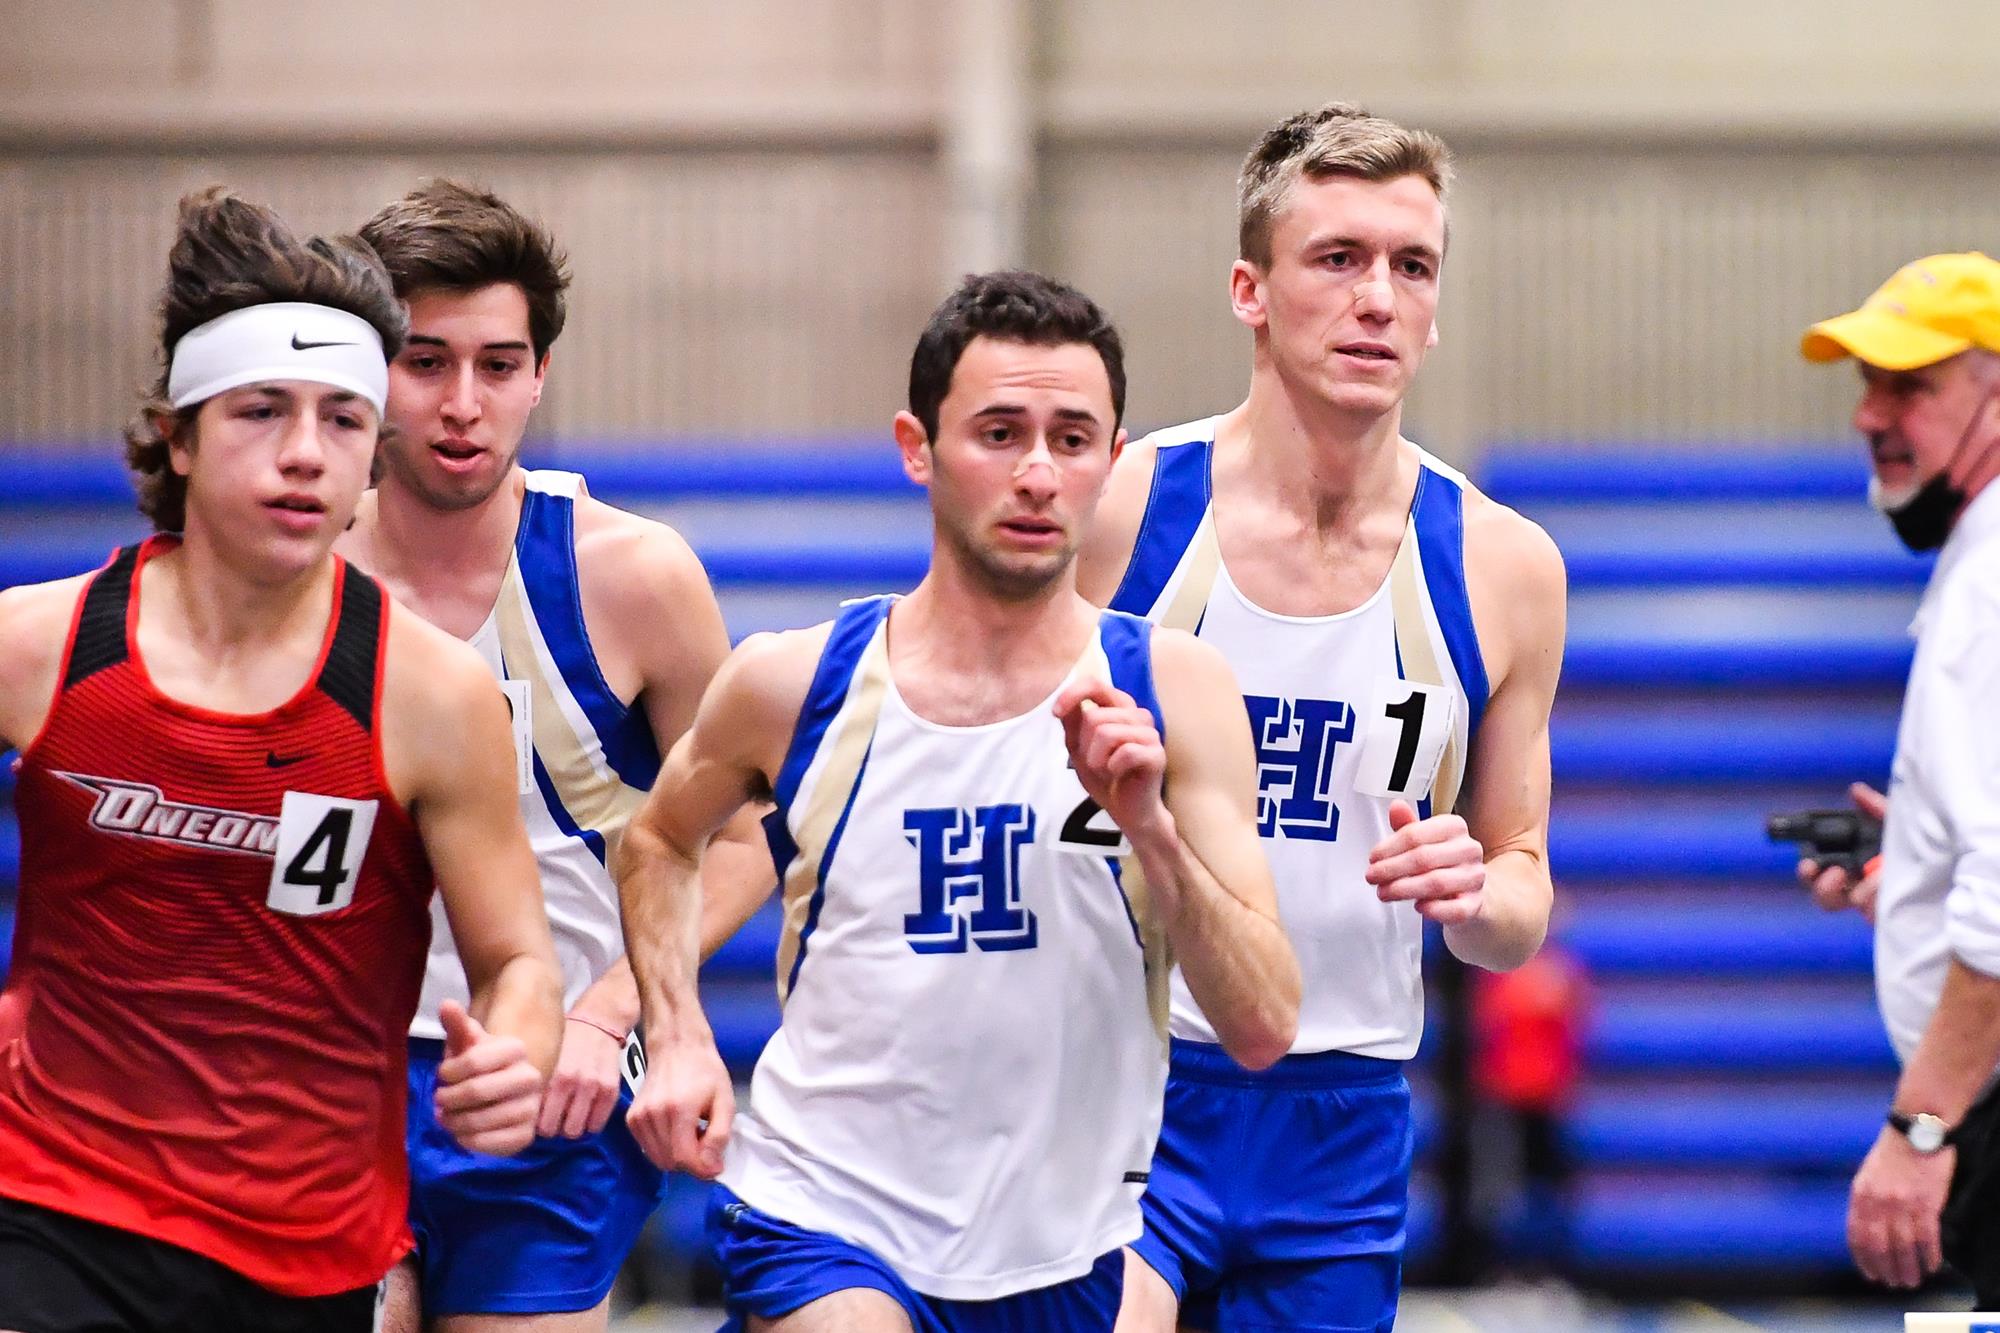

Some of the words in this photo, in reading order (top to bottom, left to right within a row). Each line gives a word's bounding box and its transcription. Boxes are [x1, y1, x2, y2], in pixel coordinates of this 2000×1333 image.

[1242, 694, 1356, 842] H
[1385, 691, 1427, 793] 1
[95, 784, 280, 852] ONEON
[284, 807, 354, 905] 4
[904, 803, 1038, 954] H
